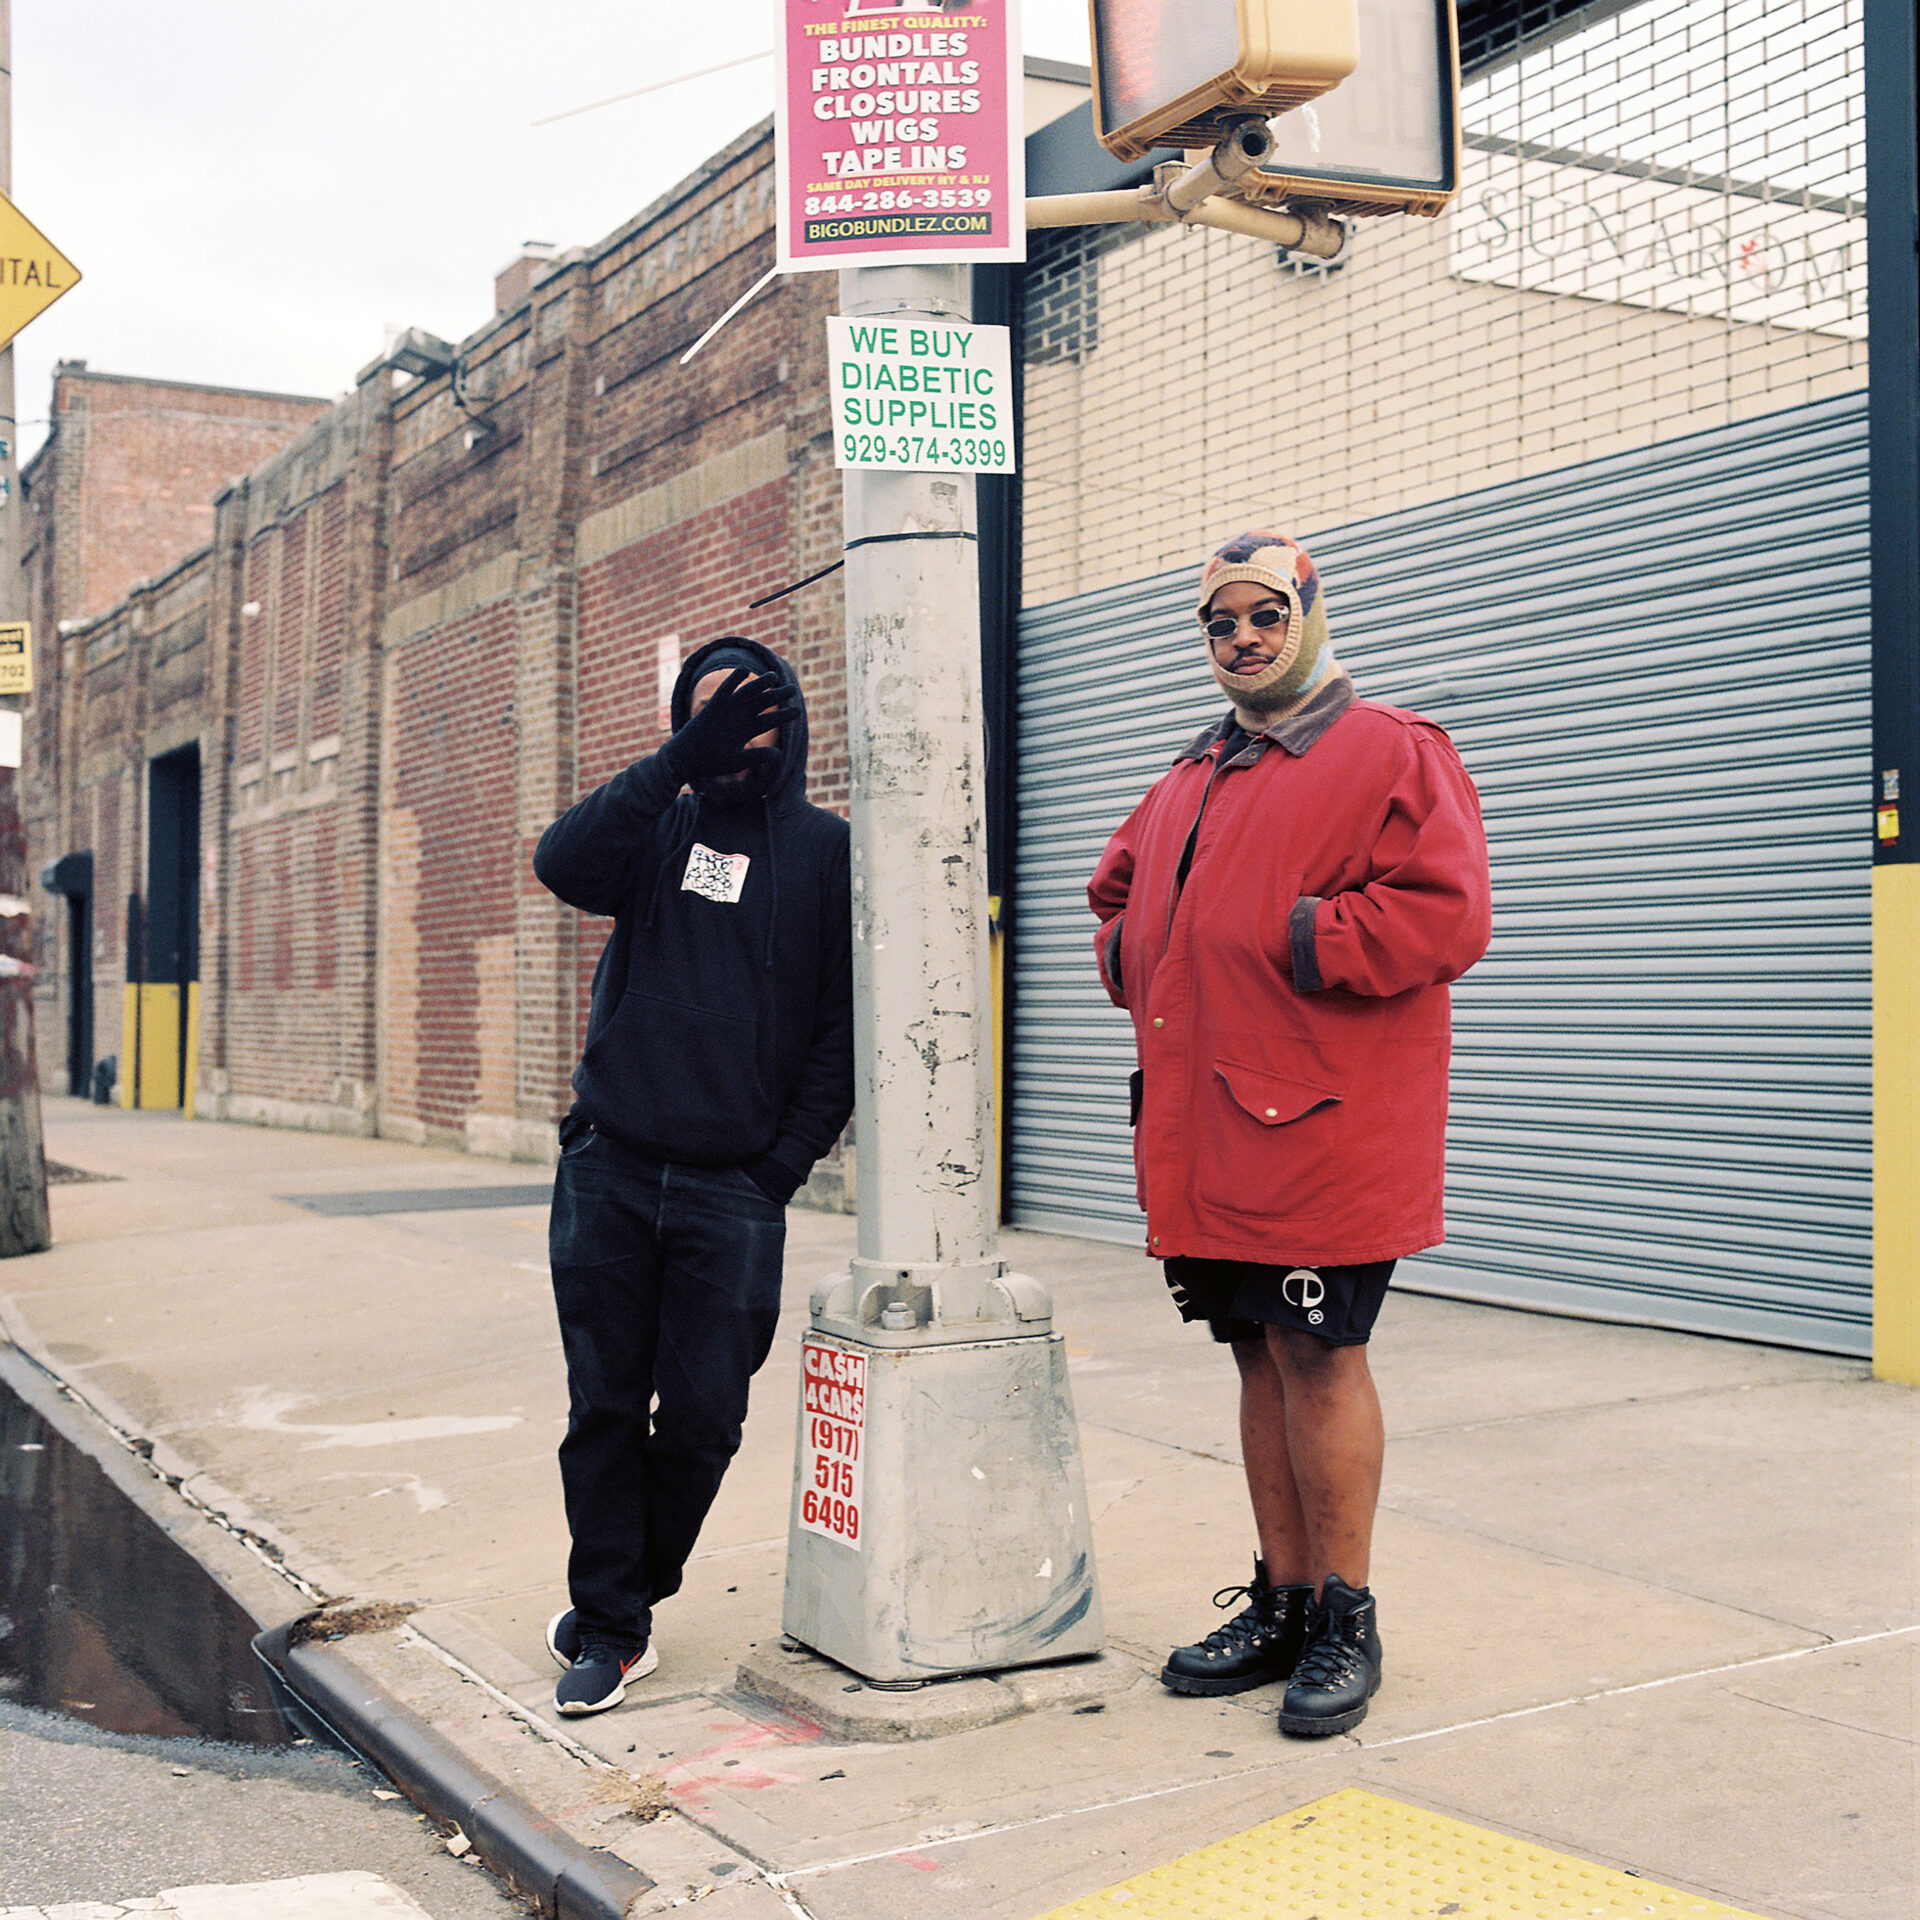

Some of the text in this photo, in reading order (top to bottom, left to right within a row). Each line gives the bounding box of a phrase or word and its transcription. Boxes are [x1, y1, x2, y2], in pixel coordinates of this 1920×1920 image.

[804, 16, 987, 36] THE FINEST QUALITY:
[819, 33, 968, 63] BUNDLES
[812, 61, 979, 92] FRONTALS
[813, 89, 980, 120] CLOSURES
[851, 118, 939, 145] WIGS
[822, 145, 967, 176] TAPE INS
[807, 175, 990, 193] SAME DAY DELIVERY NY & NJ
[804, 189, 992, 216] 844-286-3539
[809, 216, 987, 239] BIGOBUNDLEZ.COM
[1477, 187, 1860, 302] SUNAROM
[849, 326, 973, 358] WE BUY
[842, 362, 993, 395] DIABETIC
[844, 397, 997, 430] SUPPLIES
[844, 434, 1006, 466] 929-374-3399
[811, 1418, 858, 1461] (917)
[815, 1454, 852, 1498] 515
[803, 1490, 858, 1540] 6499
